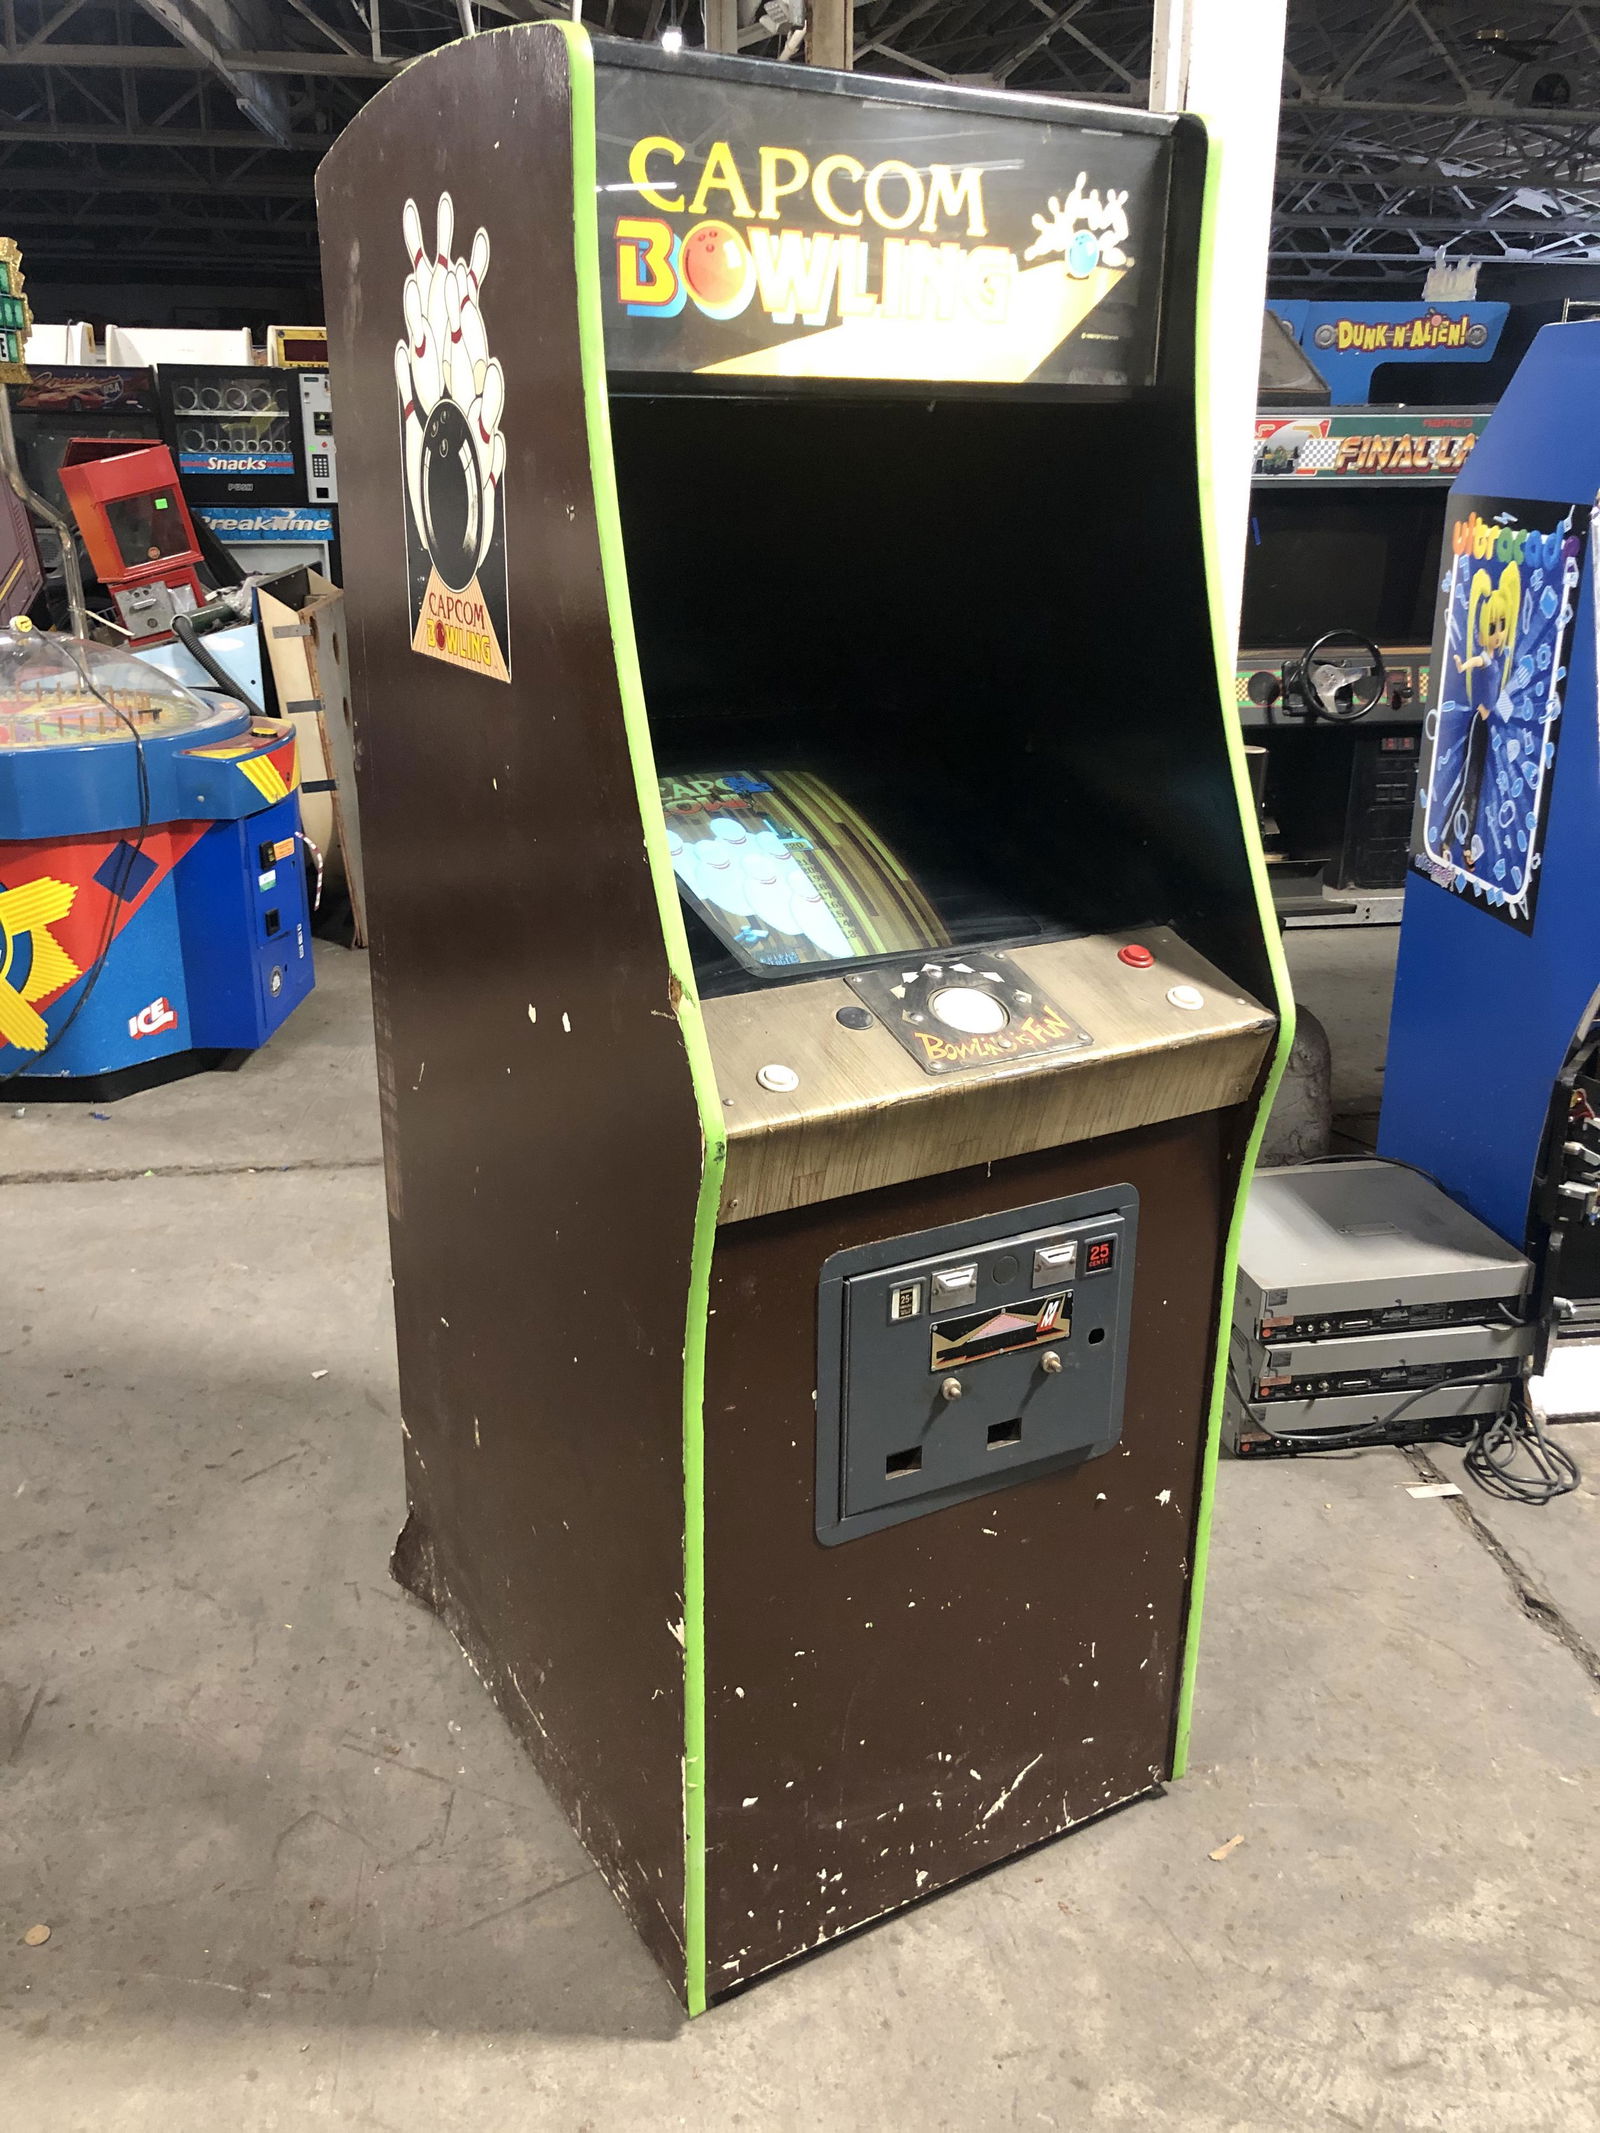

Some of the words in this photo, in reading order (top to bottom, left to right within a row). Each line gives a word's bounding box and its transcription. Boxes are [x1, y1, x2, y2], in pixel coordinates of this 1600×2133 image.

[628, 136, 990, 237] CAPCOM
[613, 216, 1016, 326] BOWLING
[1338, 320, 1388, 350] DUNK
[103, 382, 121, 395] USA
[207, 457, 267, 470] Snacks
[1335, 434, 1430, 473] FINAL
[428, 592, 485, 630] CAPCOM
[426, 618, 492, 667] BOWLING
[129, 996, 178, 1040] ICE
[1021, 1005, 1071, 1043] FUN
[1090, 1243, 1109, 1261] 25
